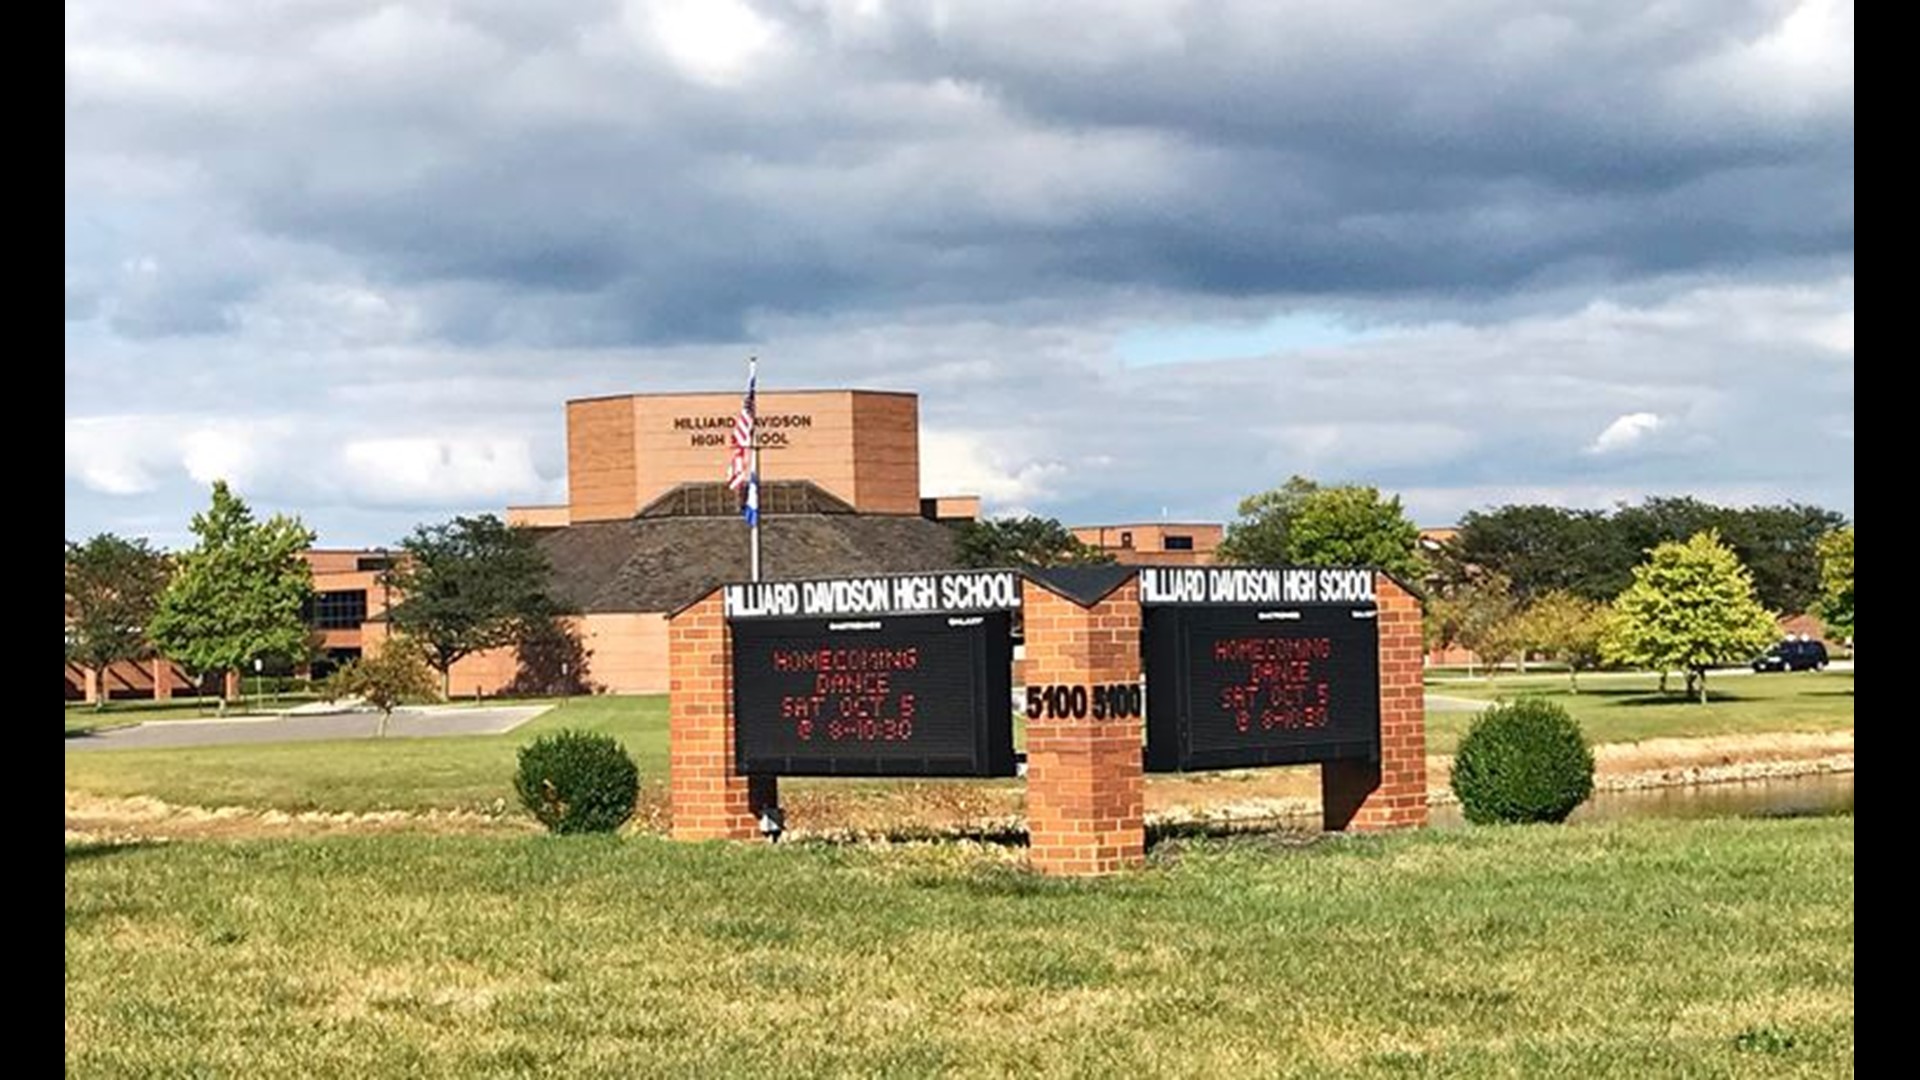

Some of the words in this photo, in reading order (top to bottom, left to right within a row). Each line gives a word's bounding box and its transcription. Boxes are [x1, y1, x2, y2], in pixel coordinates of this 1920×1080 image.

[674, 416, 737, 430] HILLIARD
[752, 414, 812, 428] AVIDSON
[691, 433, 726, 447] HIGH
[730, 431, 789, 446] SOOL
[724, 583, 799, 617] HILLIARD
[802, 579, 889, 614] DAVIDSON
[893, 576, 938, 609] HIGH
[941, 573, 1021, 609] SCHOOL
[1139, 568, 1206, 602] HILLIARD
[1208, 568, 1280, 602] DAVIDSON
[1283, 568, 1317, 602] HIGH
[1319, 568, 1377, 602] SCHOOL
[773, 648, 918, 672] HOMECOMING
[1214, 637, 1331, 660] HOMECOMING
[1251, 660, 1311, 683] DANCE
[815, 673, 891, 694] DANCE
[780, 696, 826, 718] SAT
[838, 695, 885, 718] OCT
[1026, 684, 1088, 720] 5100
[1091, 683, 1141, 721] 5100
[1220, 684, 1260, 709] SAT
[1270, 684, 1308, 707] OCT
